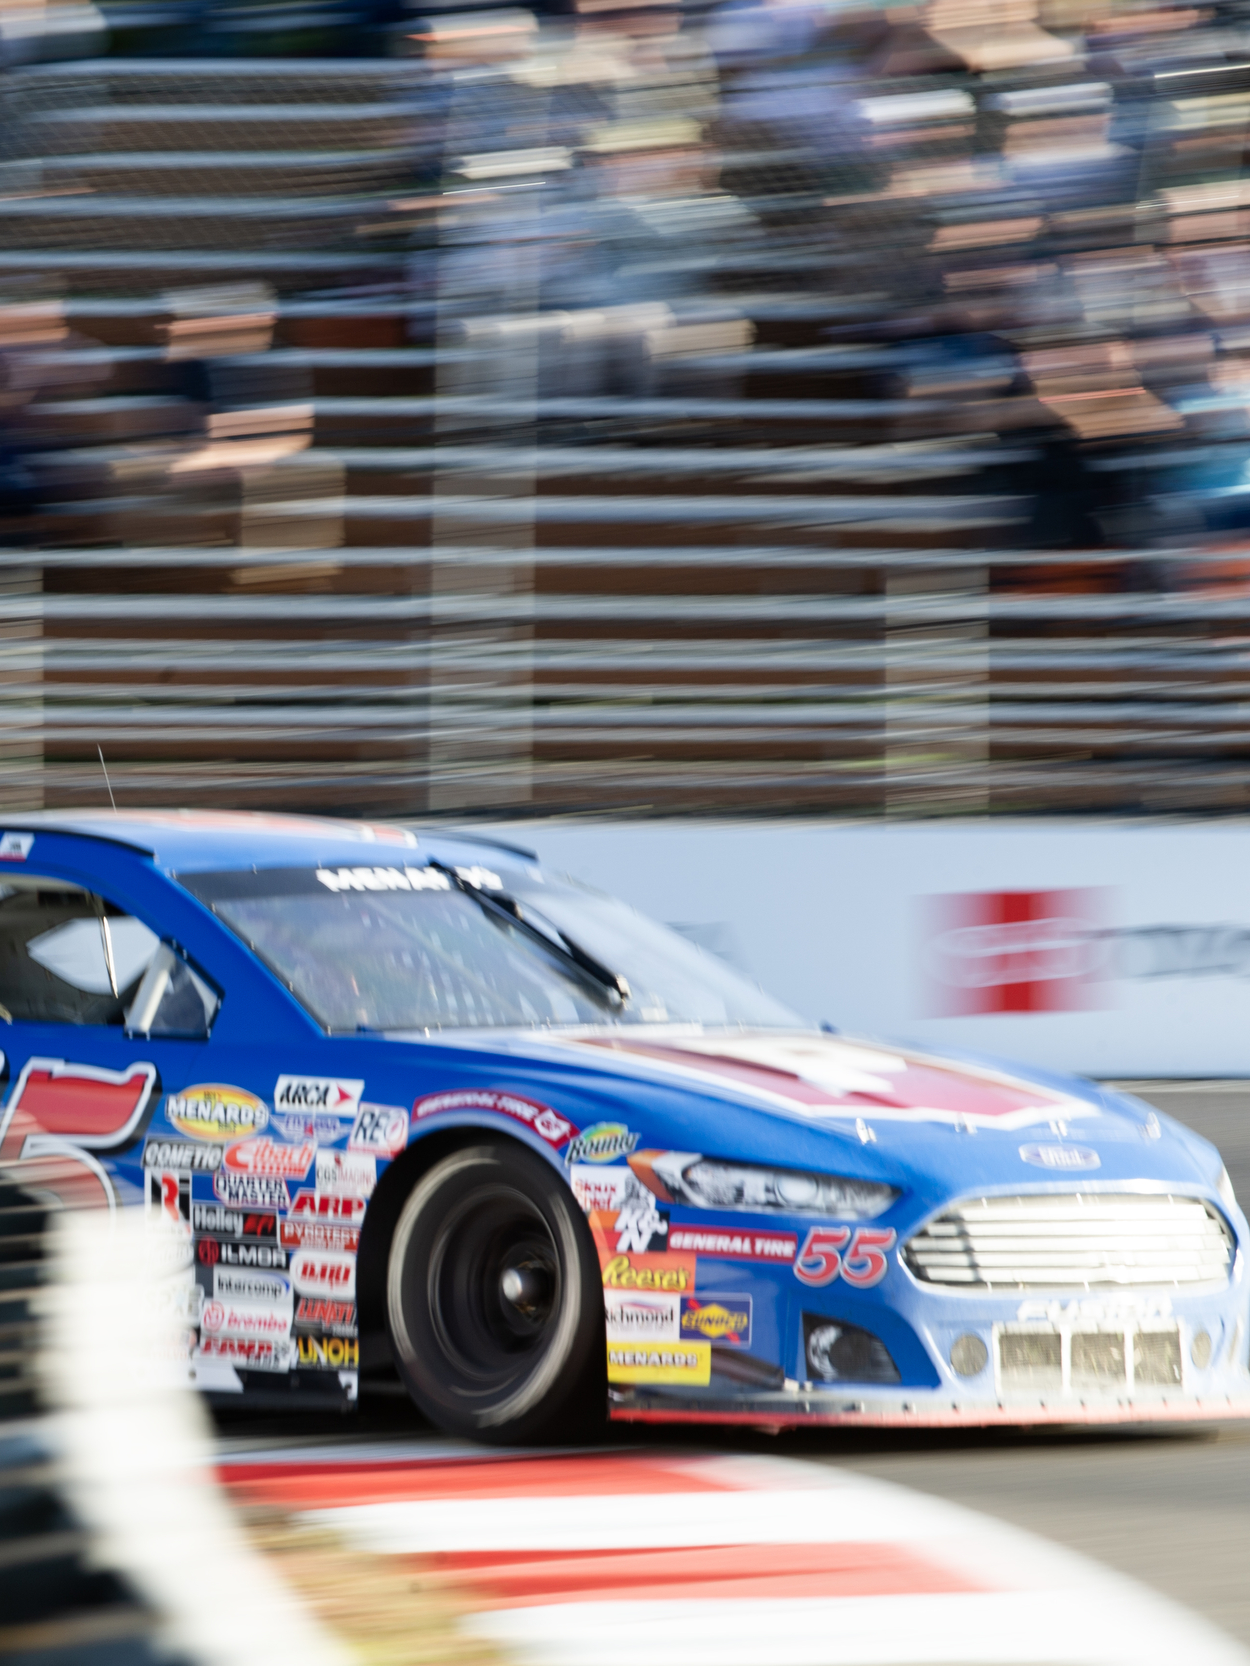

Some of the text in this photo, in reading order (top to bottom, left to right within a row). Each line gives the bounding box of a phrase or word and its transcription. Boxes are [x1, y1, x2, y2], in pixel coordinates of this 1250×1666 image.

[166, 1096, 268, 1127] MENARDS
[565, 1131, 642, 1168] Bounty
[194, 1206, 244, 1238] Holley
[669, 1232, 796, 1258] GENERAL TIRE
[793, 1226, 898, 1289] 55
[217, 1272, 284, 1299] Intercomp
[602, 1254, 688, 1292] Reese's
[227, 1311, 288, 1334] brembo
[608, 1350, 698, 1367] MENARDS
